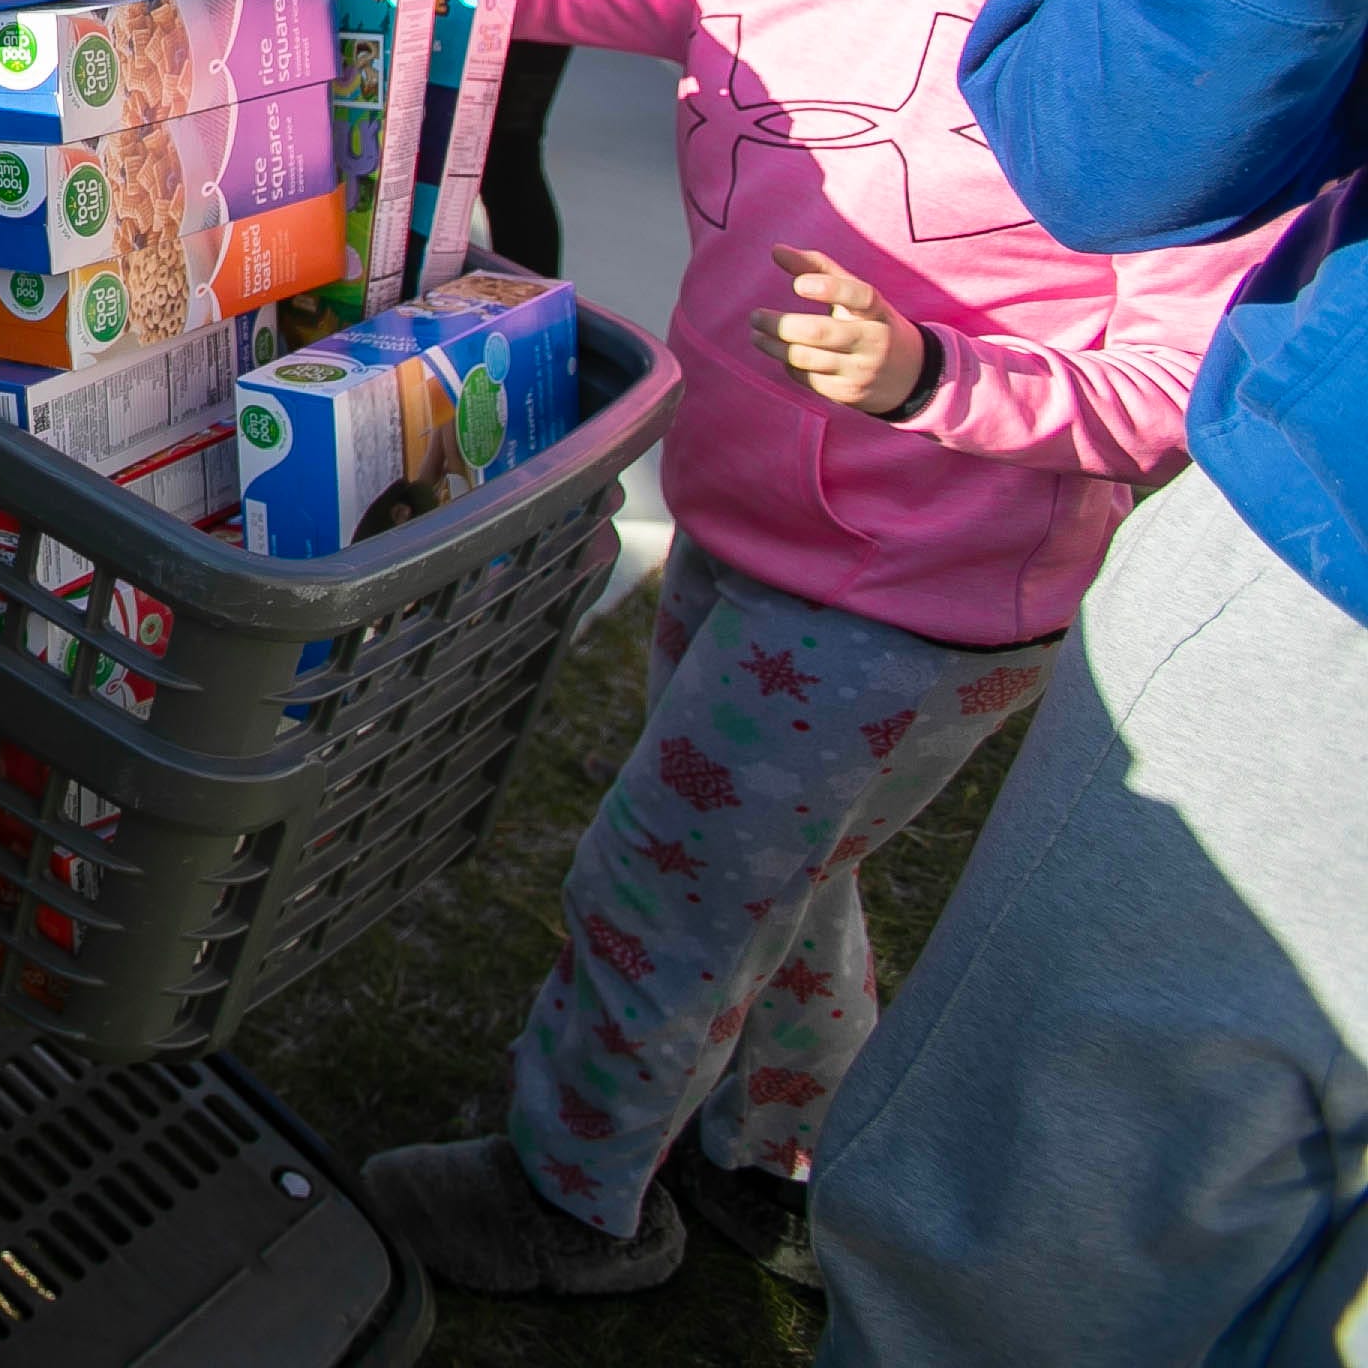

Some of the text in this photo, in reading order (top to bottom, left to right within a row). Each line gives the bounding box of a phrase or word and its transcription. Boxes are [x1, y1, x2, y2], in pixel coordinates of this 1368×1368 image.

[1, 46, 32, 62] food
[2, 33, 29, 48] club
[257, 37, 273, 85] rice
[82, 49, 96, 97] food
[95, 48, 108, 92] club
[267, 102, 284, 202] squares
[74, 180, 88, 228] food
[87, 178, 100, 224] club
[252, 157, 267, 205] rice
[240, 229, 252, 300] honey nut
[249, 223, 263, 294] toasted
[261, 248, 273, 292] oats
[15, 287, 39, 301] food
[93, 287, 106, 334] food
[104, 285, 118, 328] club
